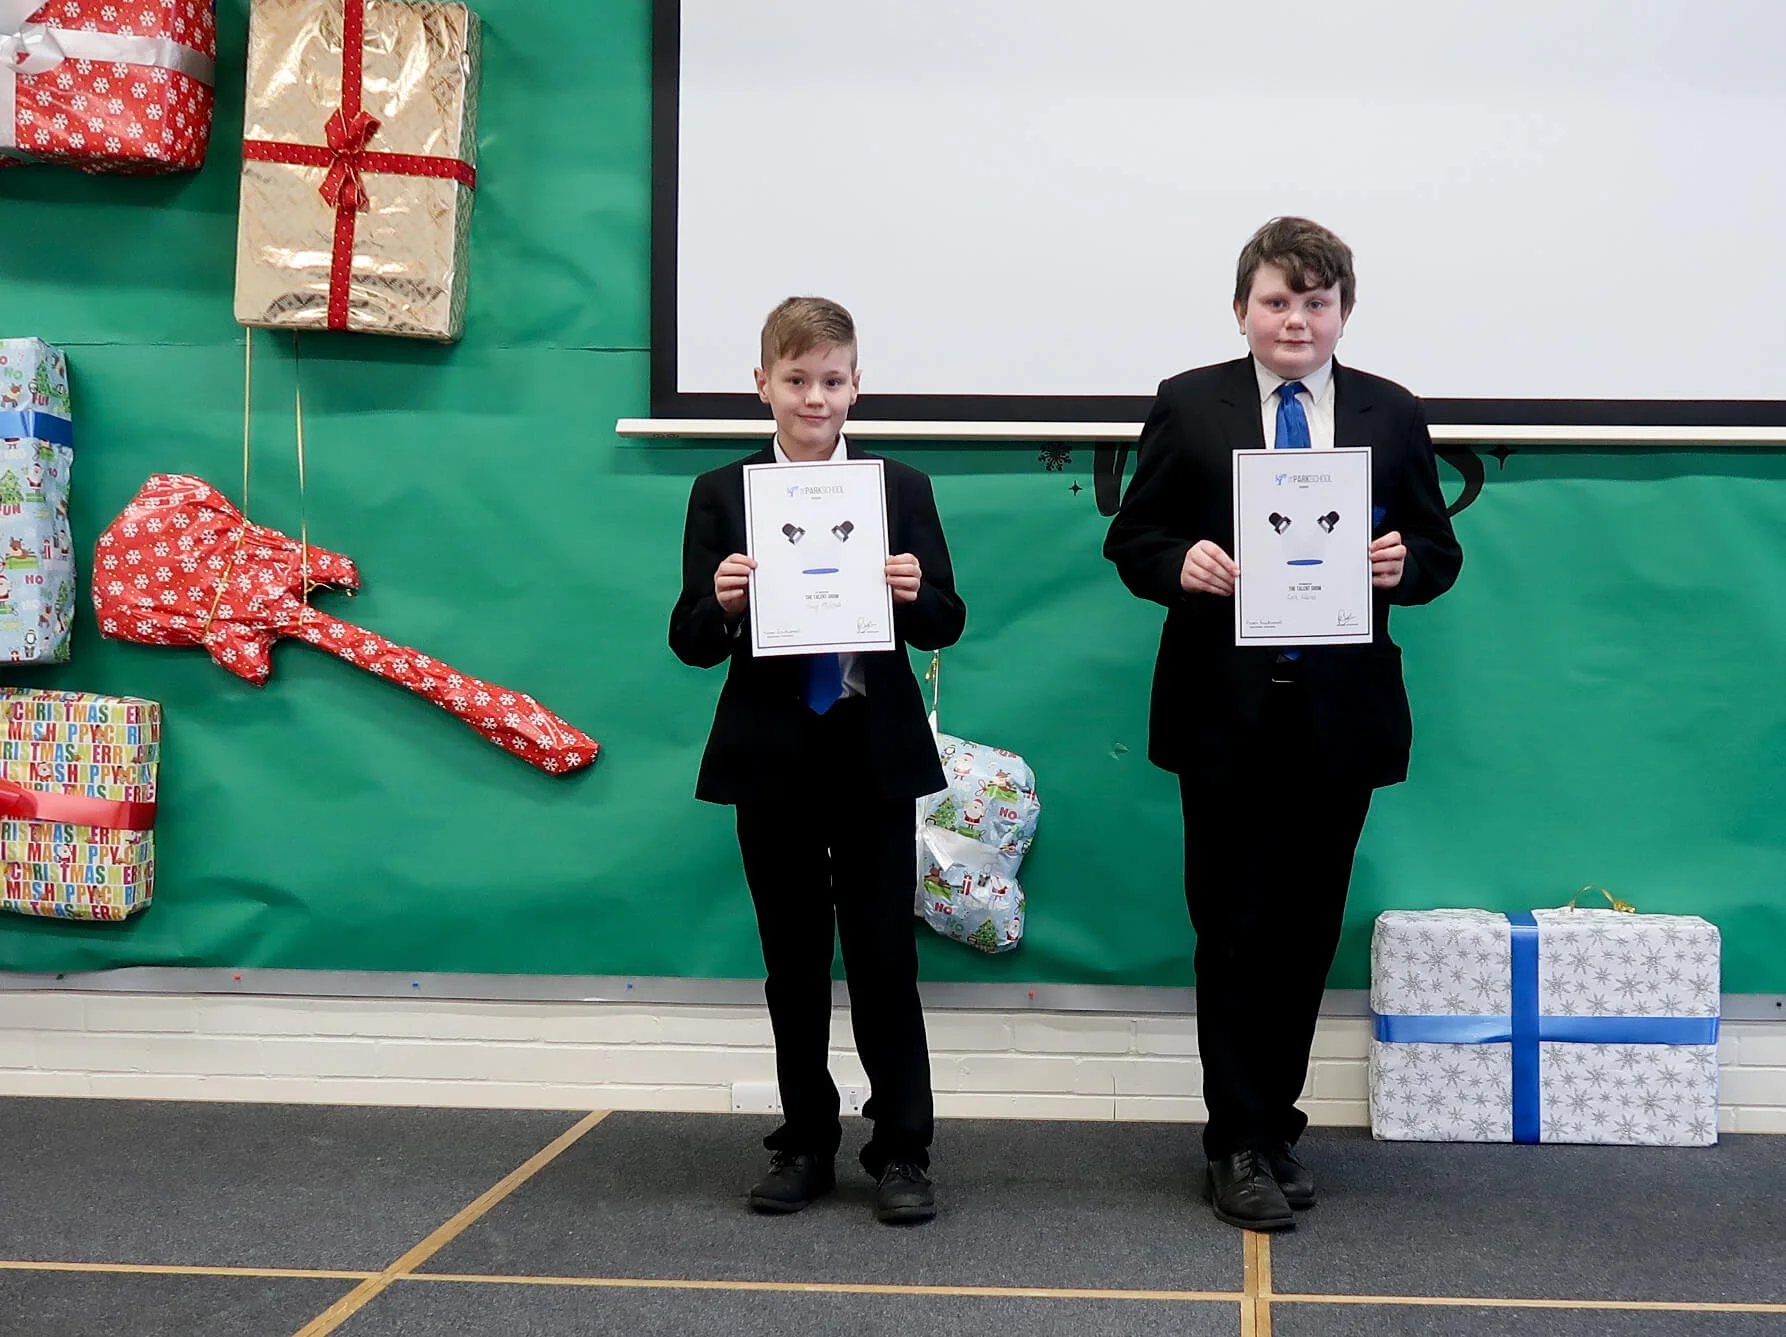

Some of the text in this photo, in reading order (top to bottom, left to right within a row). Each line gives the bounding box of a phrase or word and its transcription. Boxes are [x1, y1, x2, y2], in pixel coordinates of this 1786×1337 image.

[25, 575, 44, 585] HO
[13, 701, 109, 724] CHRISTMAS
[45, 722, 101, 743] HAPPY
[67, 763, 121, 784] HAPPY
[999, 807, 1018, 821] HO
[11, 861, 105, 884] CHRISTMAS
[45, 882, 97, 904] HAPPY
[935, 902, 953, 915] HO
